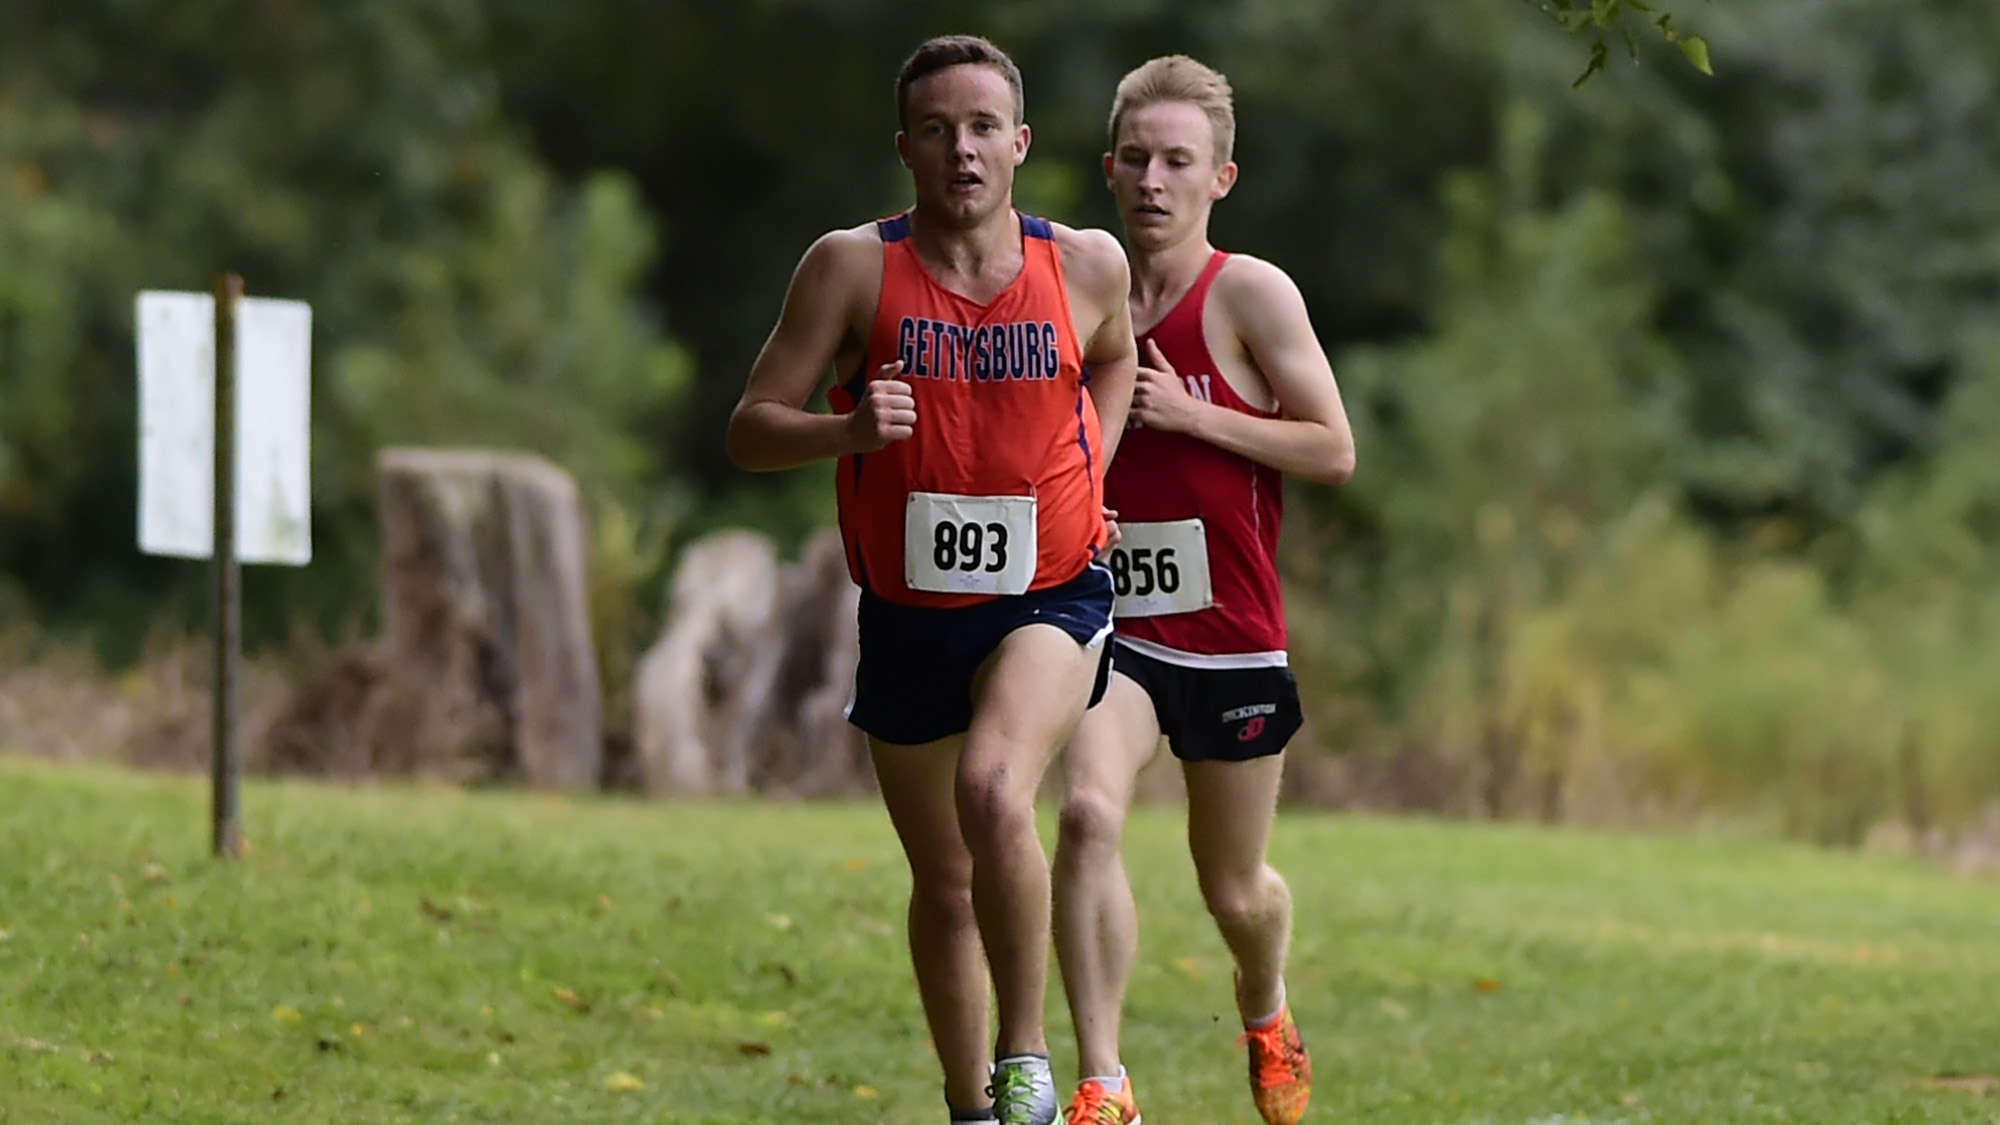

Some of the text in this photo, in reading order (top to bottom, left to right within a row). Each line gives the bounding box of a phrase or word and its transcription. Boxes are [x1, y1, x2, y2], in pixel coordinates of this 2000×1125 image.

[899, 316, 1059, 383] GETTYSBURG
[933, 521, 1008, 573] 893
[1110, 547, 1180, 597] 856
